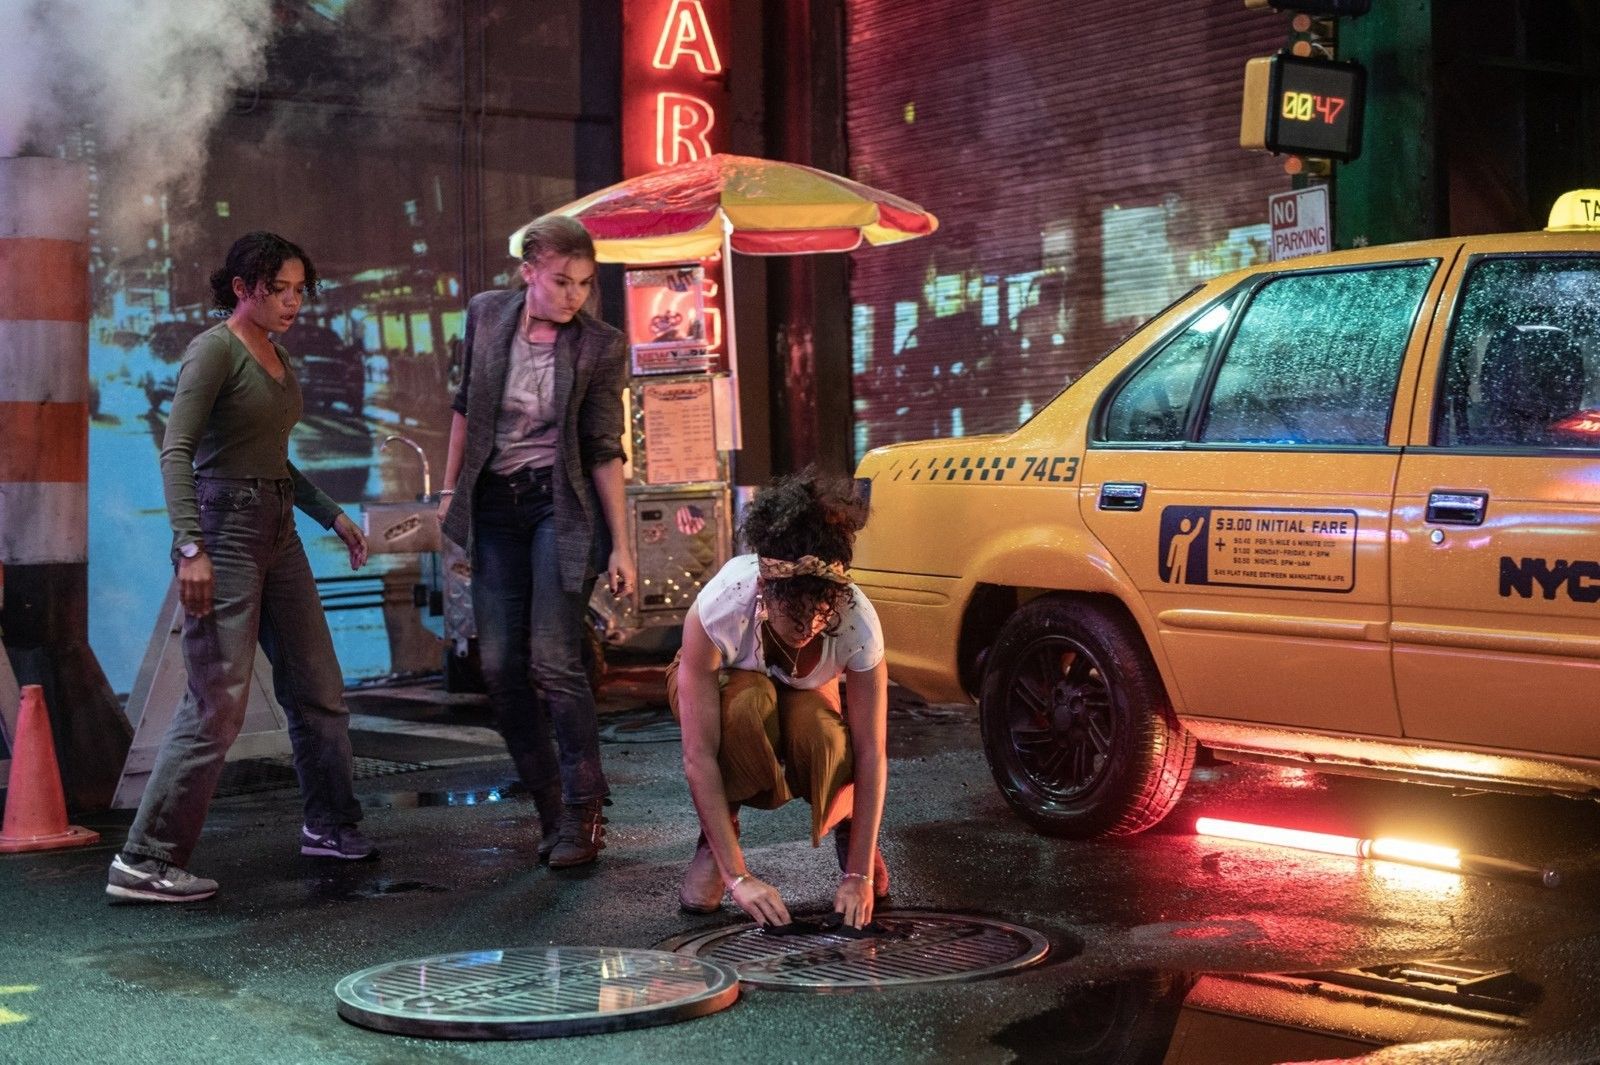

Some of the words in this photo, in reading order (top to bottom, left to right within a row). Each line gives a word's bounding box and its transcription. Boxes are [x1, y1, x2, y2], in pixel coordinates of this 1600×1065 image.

[1273, 200, 1296, 225] NO
[1275, 227, 1325, 253] PARKING
[1020, 457, 1080, 482] 74C3
[1216, 518, 1252, 531] $3.00
[1256, 519, 1305, 533] INITIAL
[1312, 520, 1347, 534] FARE
[1289, 573, 1326, 581] MANHATTAN
[1498, 556, 1600, 604] NYC
